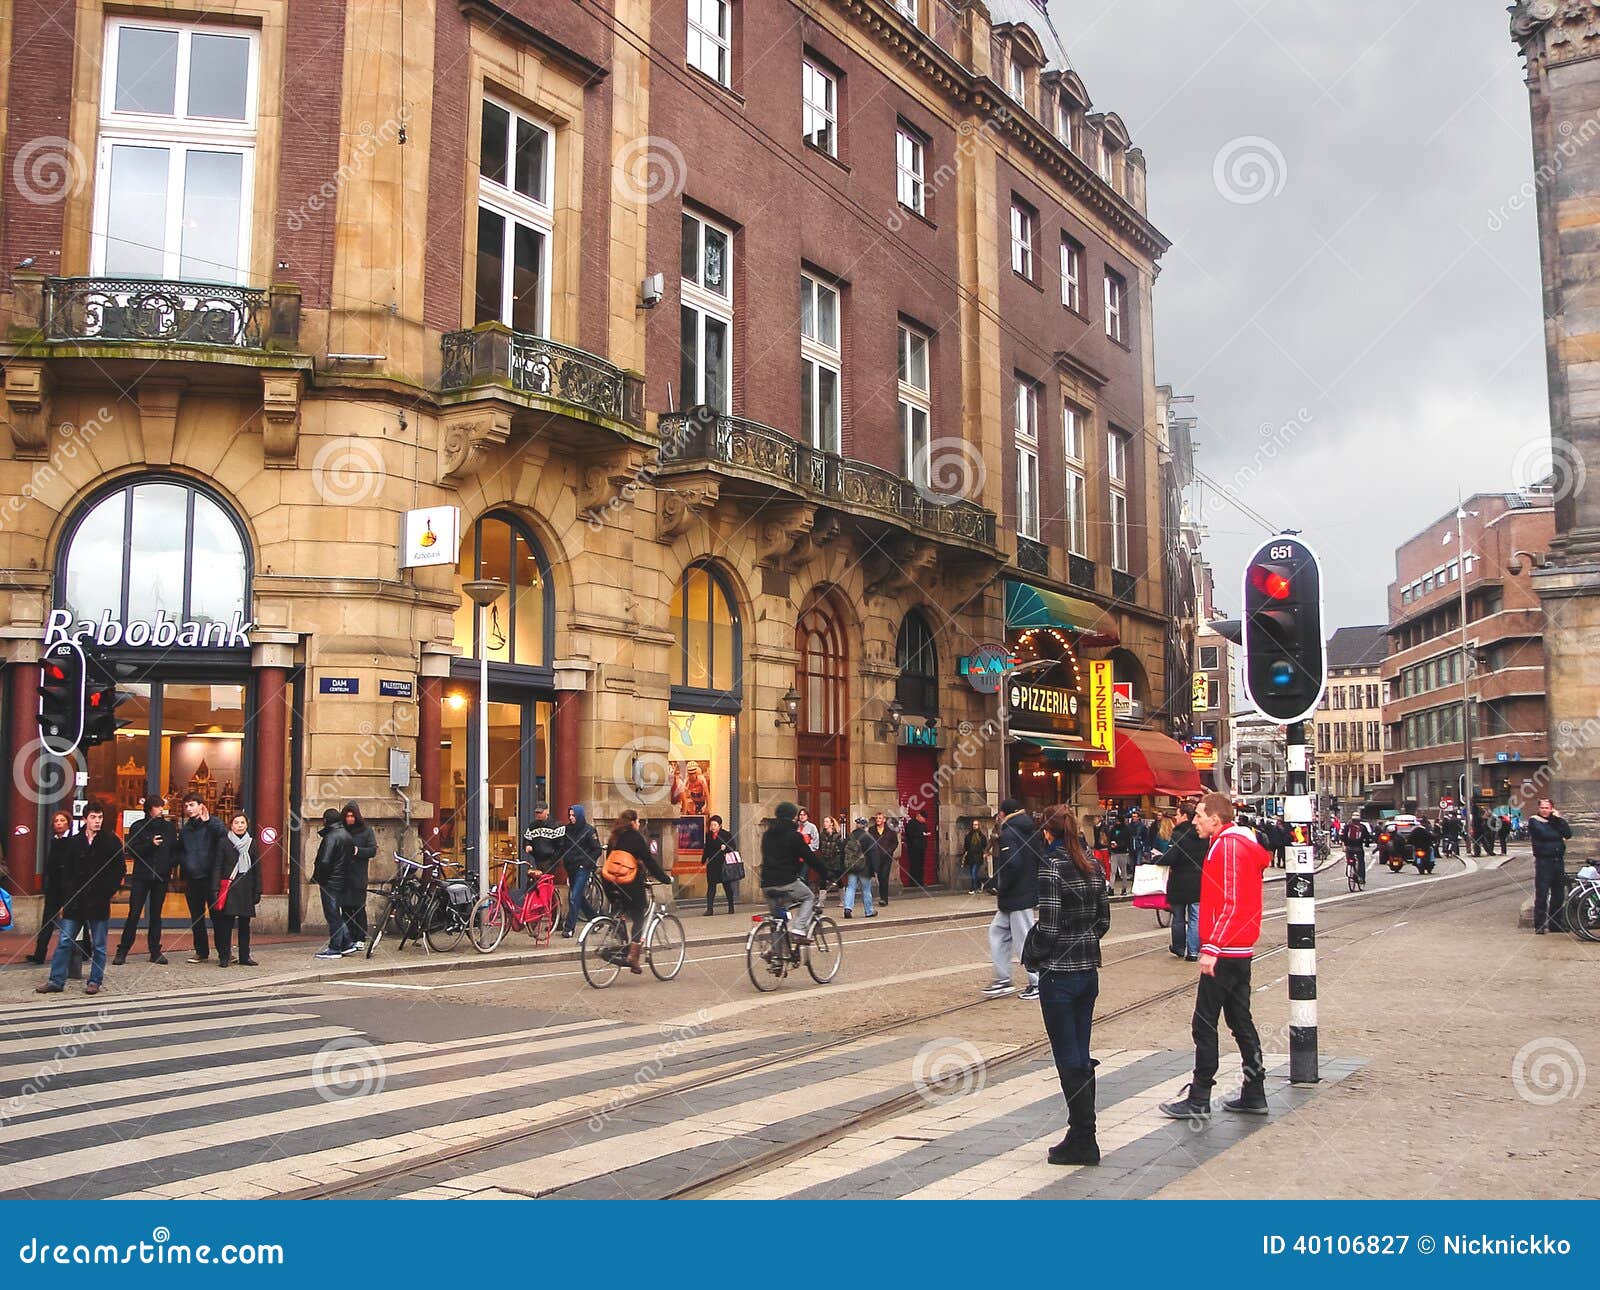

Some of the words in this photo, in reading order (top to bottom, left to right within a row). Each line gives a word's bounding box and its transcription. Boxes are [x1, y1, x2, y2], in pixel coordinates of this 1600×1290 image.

[1270, 545, 1292, 560] 651
[44, 608, 253, 648] Rabobank
[57, 646, 71, 656] 652
[332, 679, 347, 687] DAM
[1020, 686, 1069, 715] PIZZERIA
[1095, 662, 1107, 752] PIZZERIA
